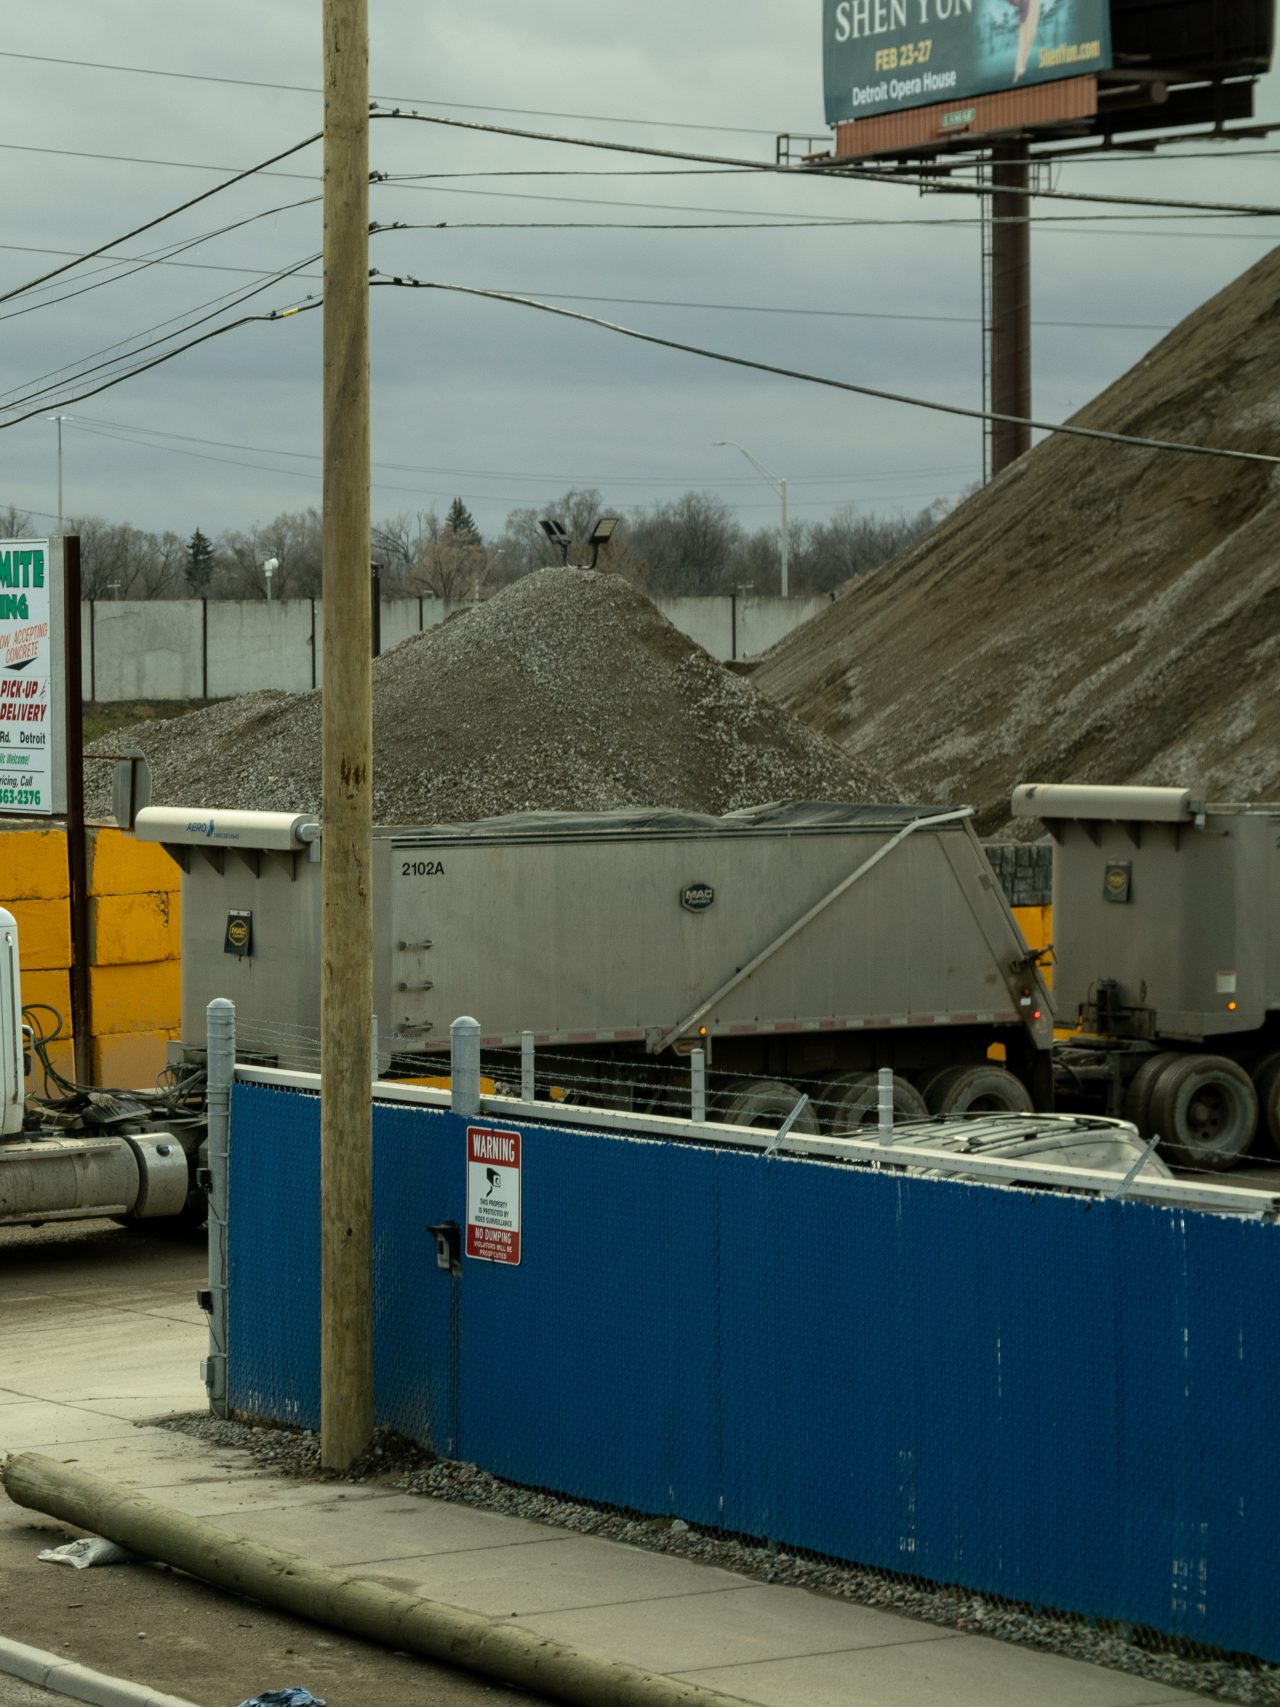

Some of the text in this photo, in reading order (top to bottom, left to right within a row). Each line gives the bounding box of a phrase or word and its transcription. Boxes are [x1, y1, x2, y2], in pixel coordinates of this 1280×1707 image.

[835, 0, 907, 42] SHEN
[875, 39, 932, 72] FEB 23-27
[852, 70, 956, 106] Detroit Opera House
[13, 622, 48, 645] ACCEPTING
[5, 641, 39, 663] CONCRETE
[0, 680, 38, 698] PICK-UP
[0, 703, 47, 722] DELIVERY
[0, 731, 11, 743] Rd.
[20, 731, 46, 744] Detroit
[20, 775, 33, 786] Call
[187, 821, 207, 832] AERO
[402, 861, 444, 876] 2102A
[686, 889, 712, 900] MAC
[231, 926, 246, 935] MAC
[473, 1133, 515, 1162] WARNING
[480, 1198, 508, 1208] THIS PROPERTY
[483, 1207, 503, 1217] PROTECTED
[504, 1210, 509, 1218] BY
[474, 1215, 512, 1228] VIDEO SURVEILLANCE
[475, 1227, 512, 1245] NO DUMPING
[474, 1240, 496, 1250] VIOLATORS
[507, 1245, 512, 1253] BE
[480, 1249, 507, 1260] PROSECUTED
